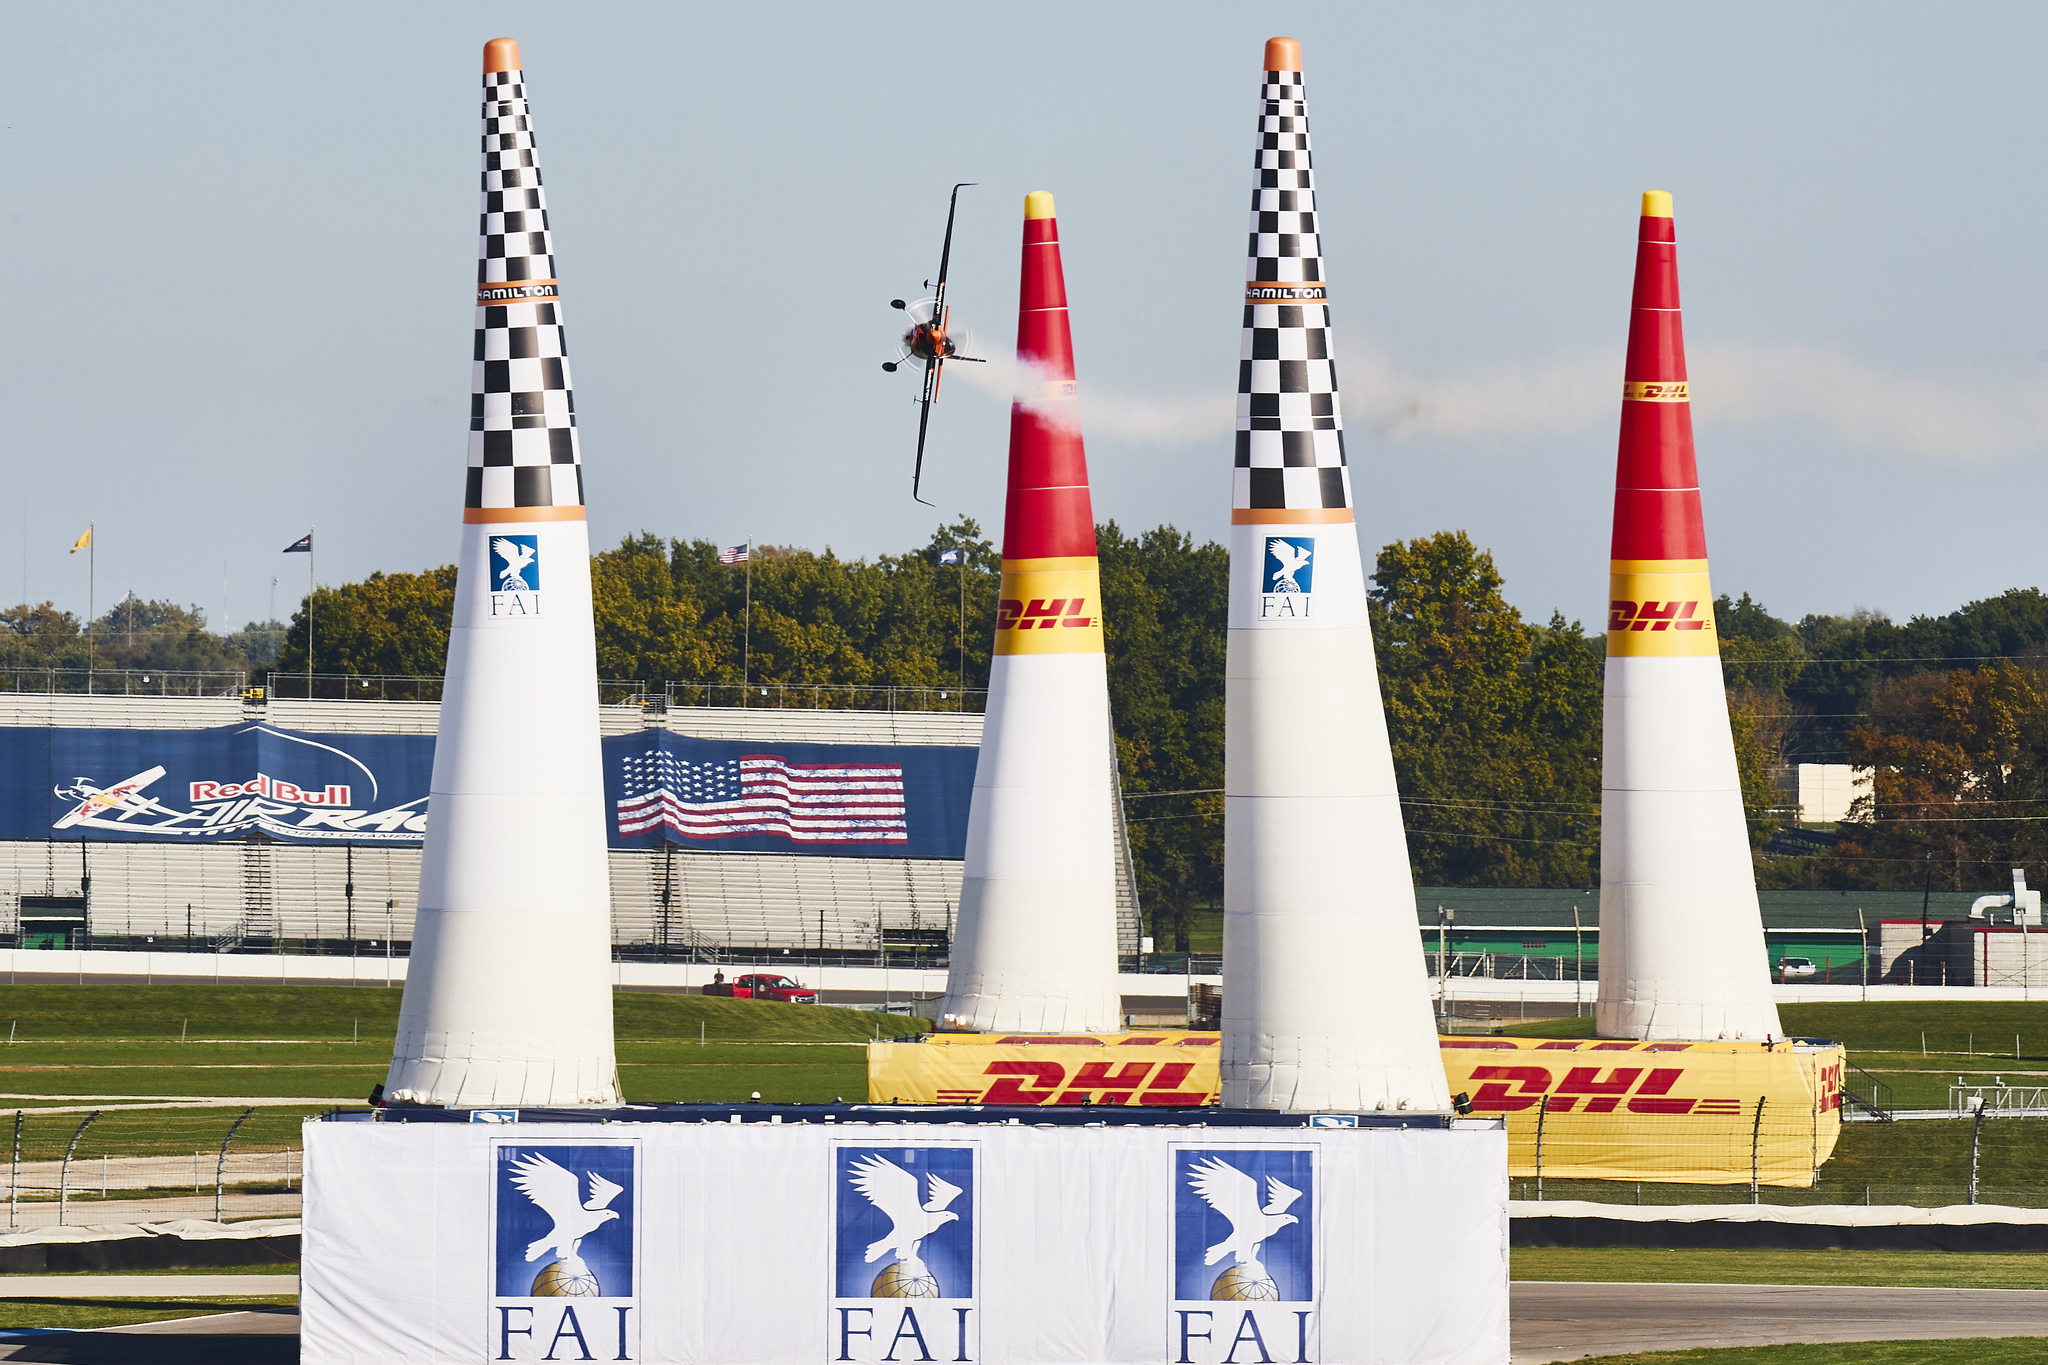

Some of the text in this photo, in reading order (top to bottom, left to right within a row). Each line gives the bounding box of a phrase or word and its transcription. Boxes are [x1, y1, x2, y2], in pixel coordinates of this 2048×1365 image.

[1643, 385, 1686, 398] DHL
[491, 594, 540, 615] FAI
[996, 598, 1092, 630] DHL
[1261, 596, 1311, 617] FAI
[1608, 600, 1704, 631] DHL
[193, 776, 348, 805] Red Bull
[186, 797, 300, 828] AIR
[978, 1061, 1210, 1106] DHL
[1469, 1066, 1699, 1114] DHL
[495, 1305, 633, 1361] FAI
[835, 1306, 973, 1362] FAI
[1175, 1309, 1313, 1365] FAI
